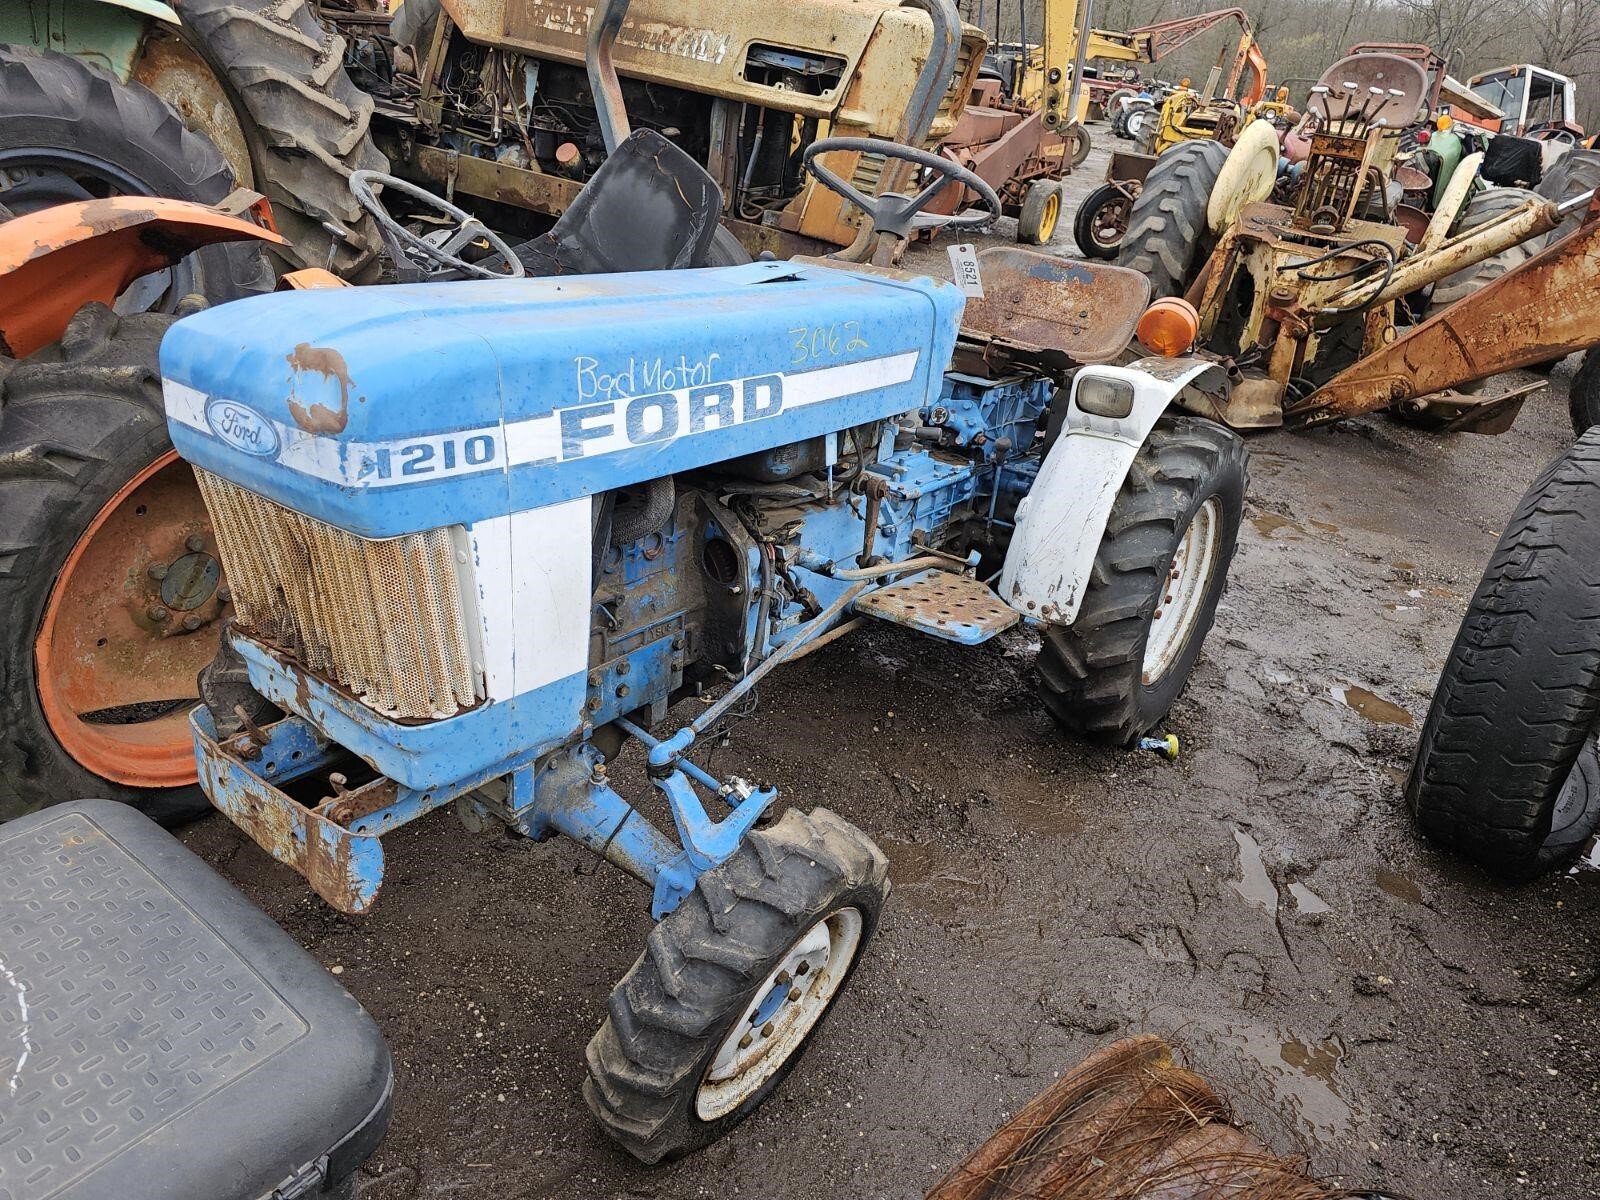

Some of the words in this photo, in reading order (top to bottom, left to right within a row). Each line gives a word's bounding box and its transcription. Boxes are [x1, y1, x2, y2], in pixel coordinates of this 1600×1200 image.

[963, 261, 978, 286] 8521
[788, 320, 869, 363] 3062
[574, 355, 635, 401] Bad
[643, 352, 721, 393] Motor
[221, 406, 262, 445] Ford
[560, 374, 784, 461] FORD
[375, 434, 496, 480] 1210
